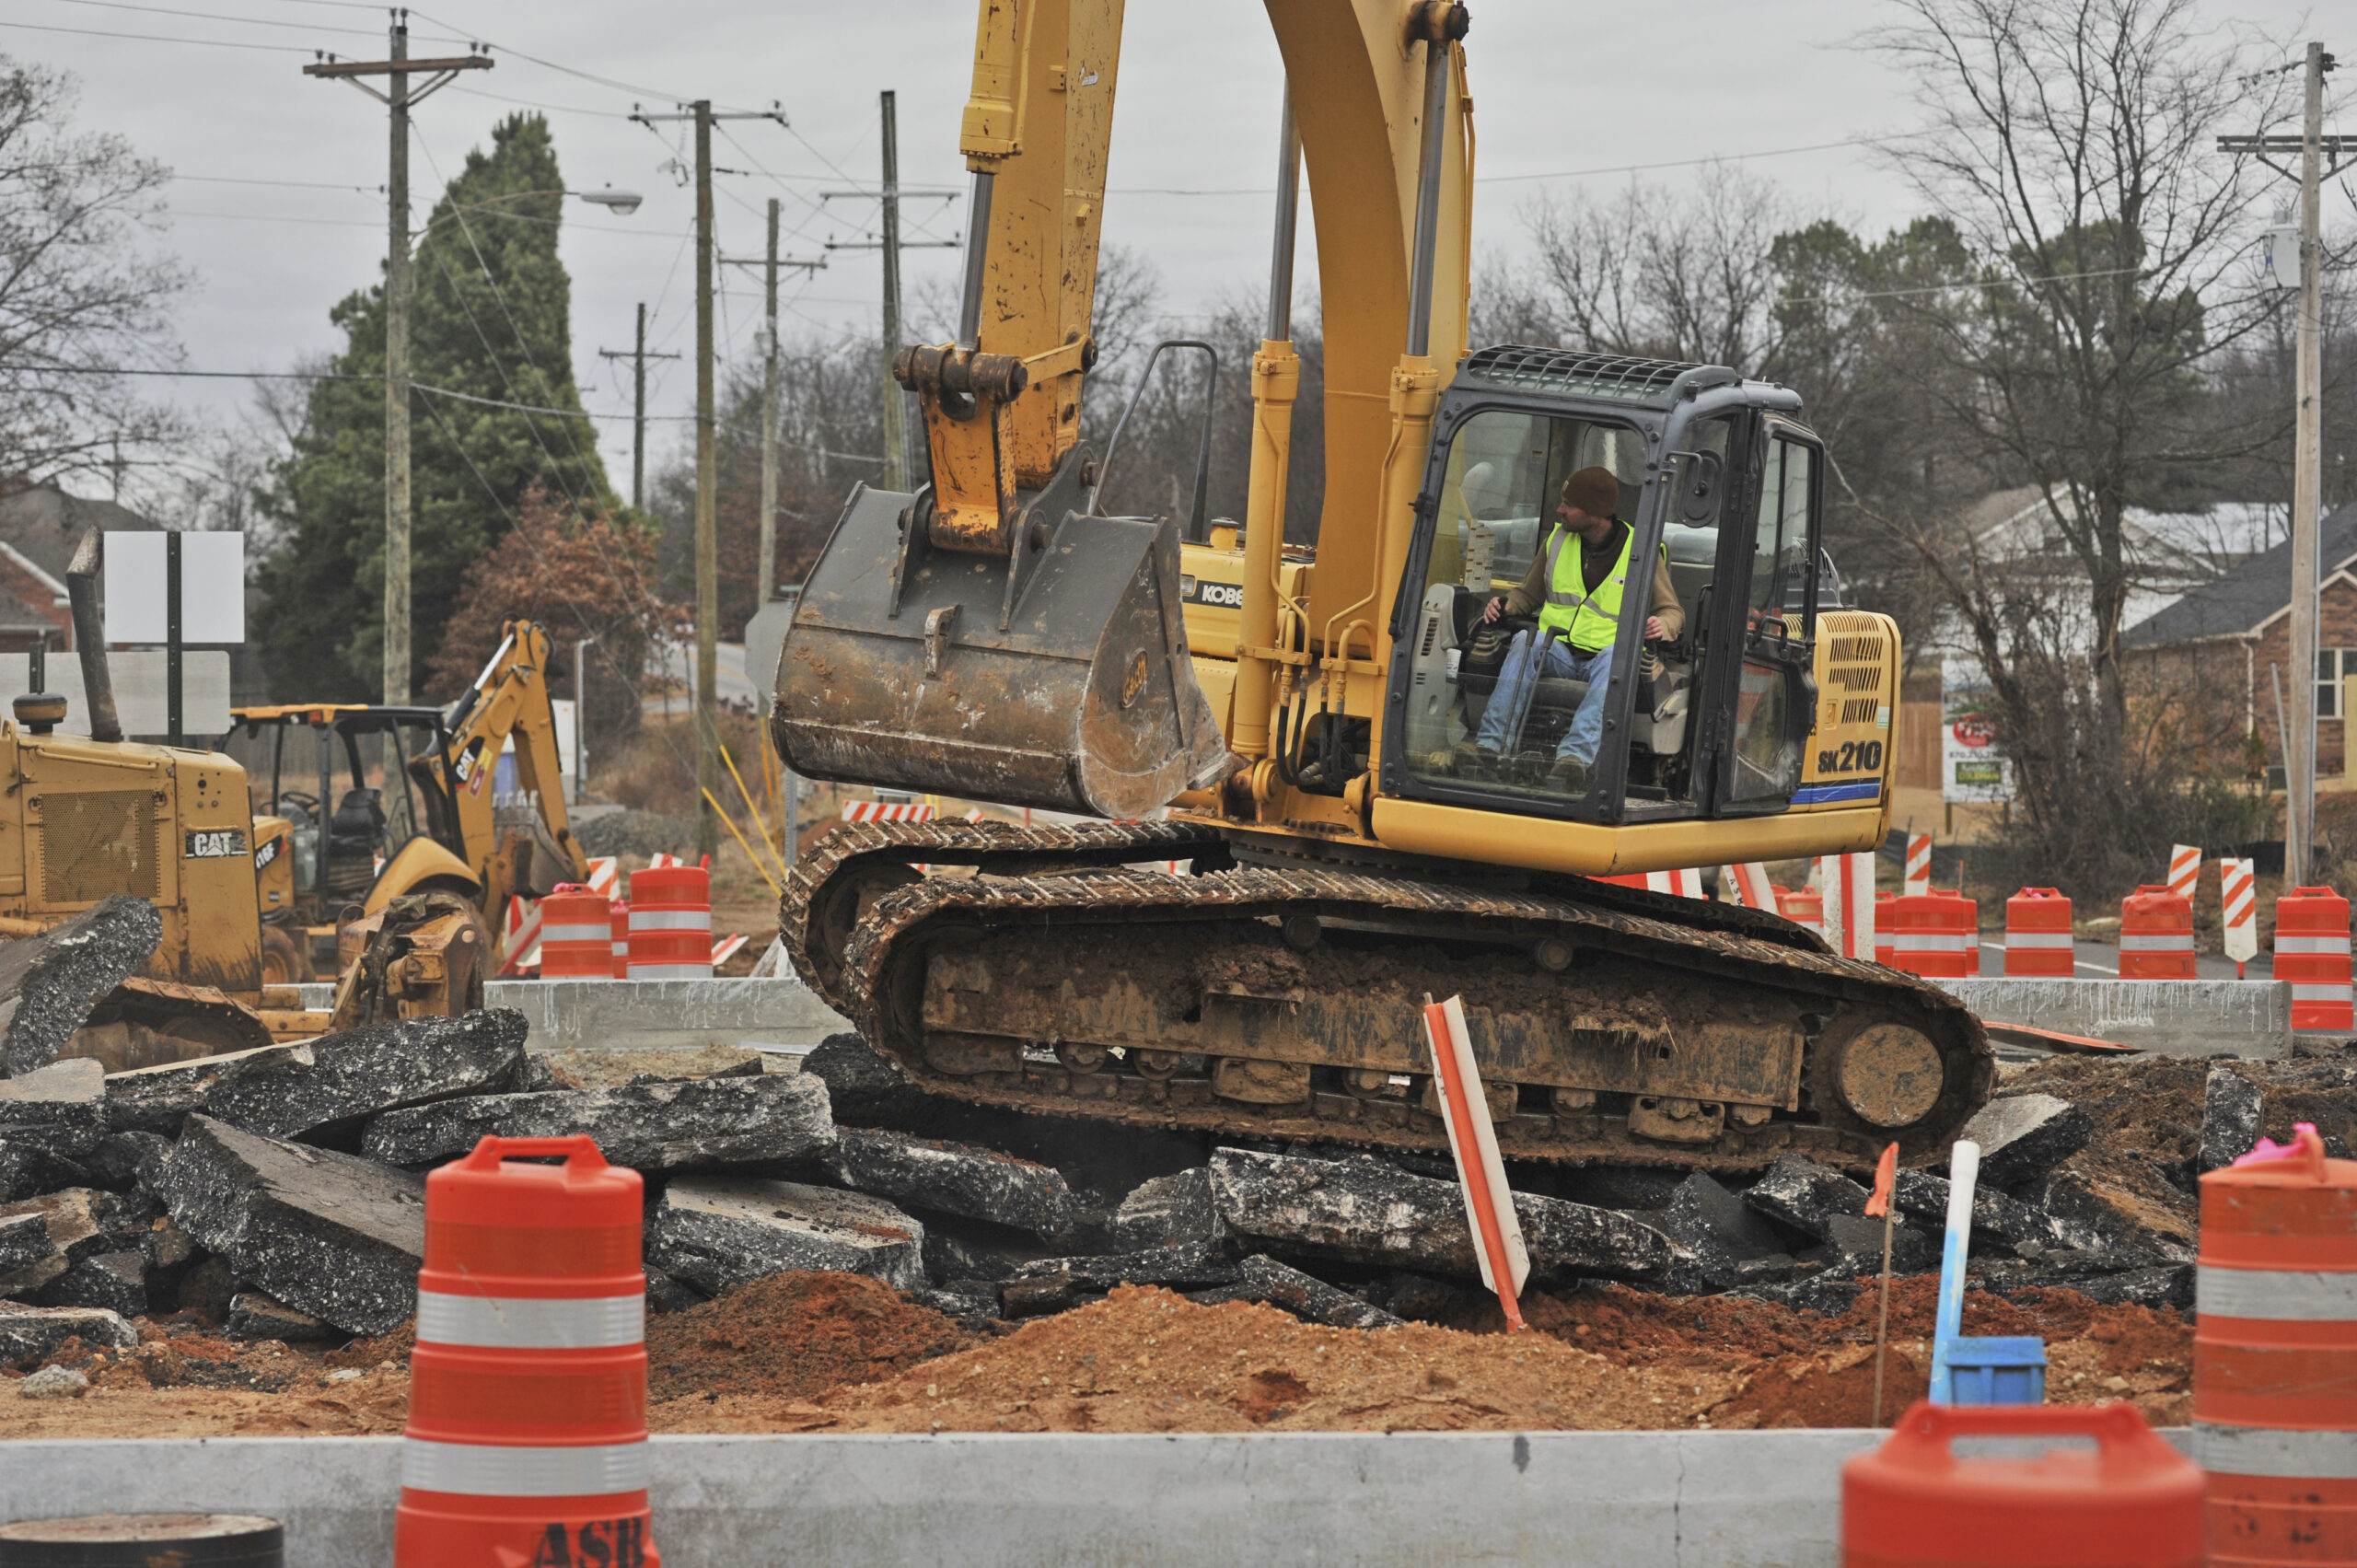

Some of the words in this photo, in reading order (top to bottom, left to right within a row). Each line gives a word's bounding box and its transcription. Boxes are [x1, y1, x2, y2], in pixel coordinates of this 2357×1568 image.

[456, 747, 475, 781] CAT
[1817, 739, 1882, 772] SK210
[194, 832, 232, 856] CAT
